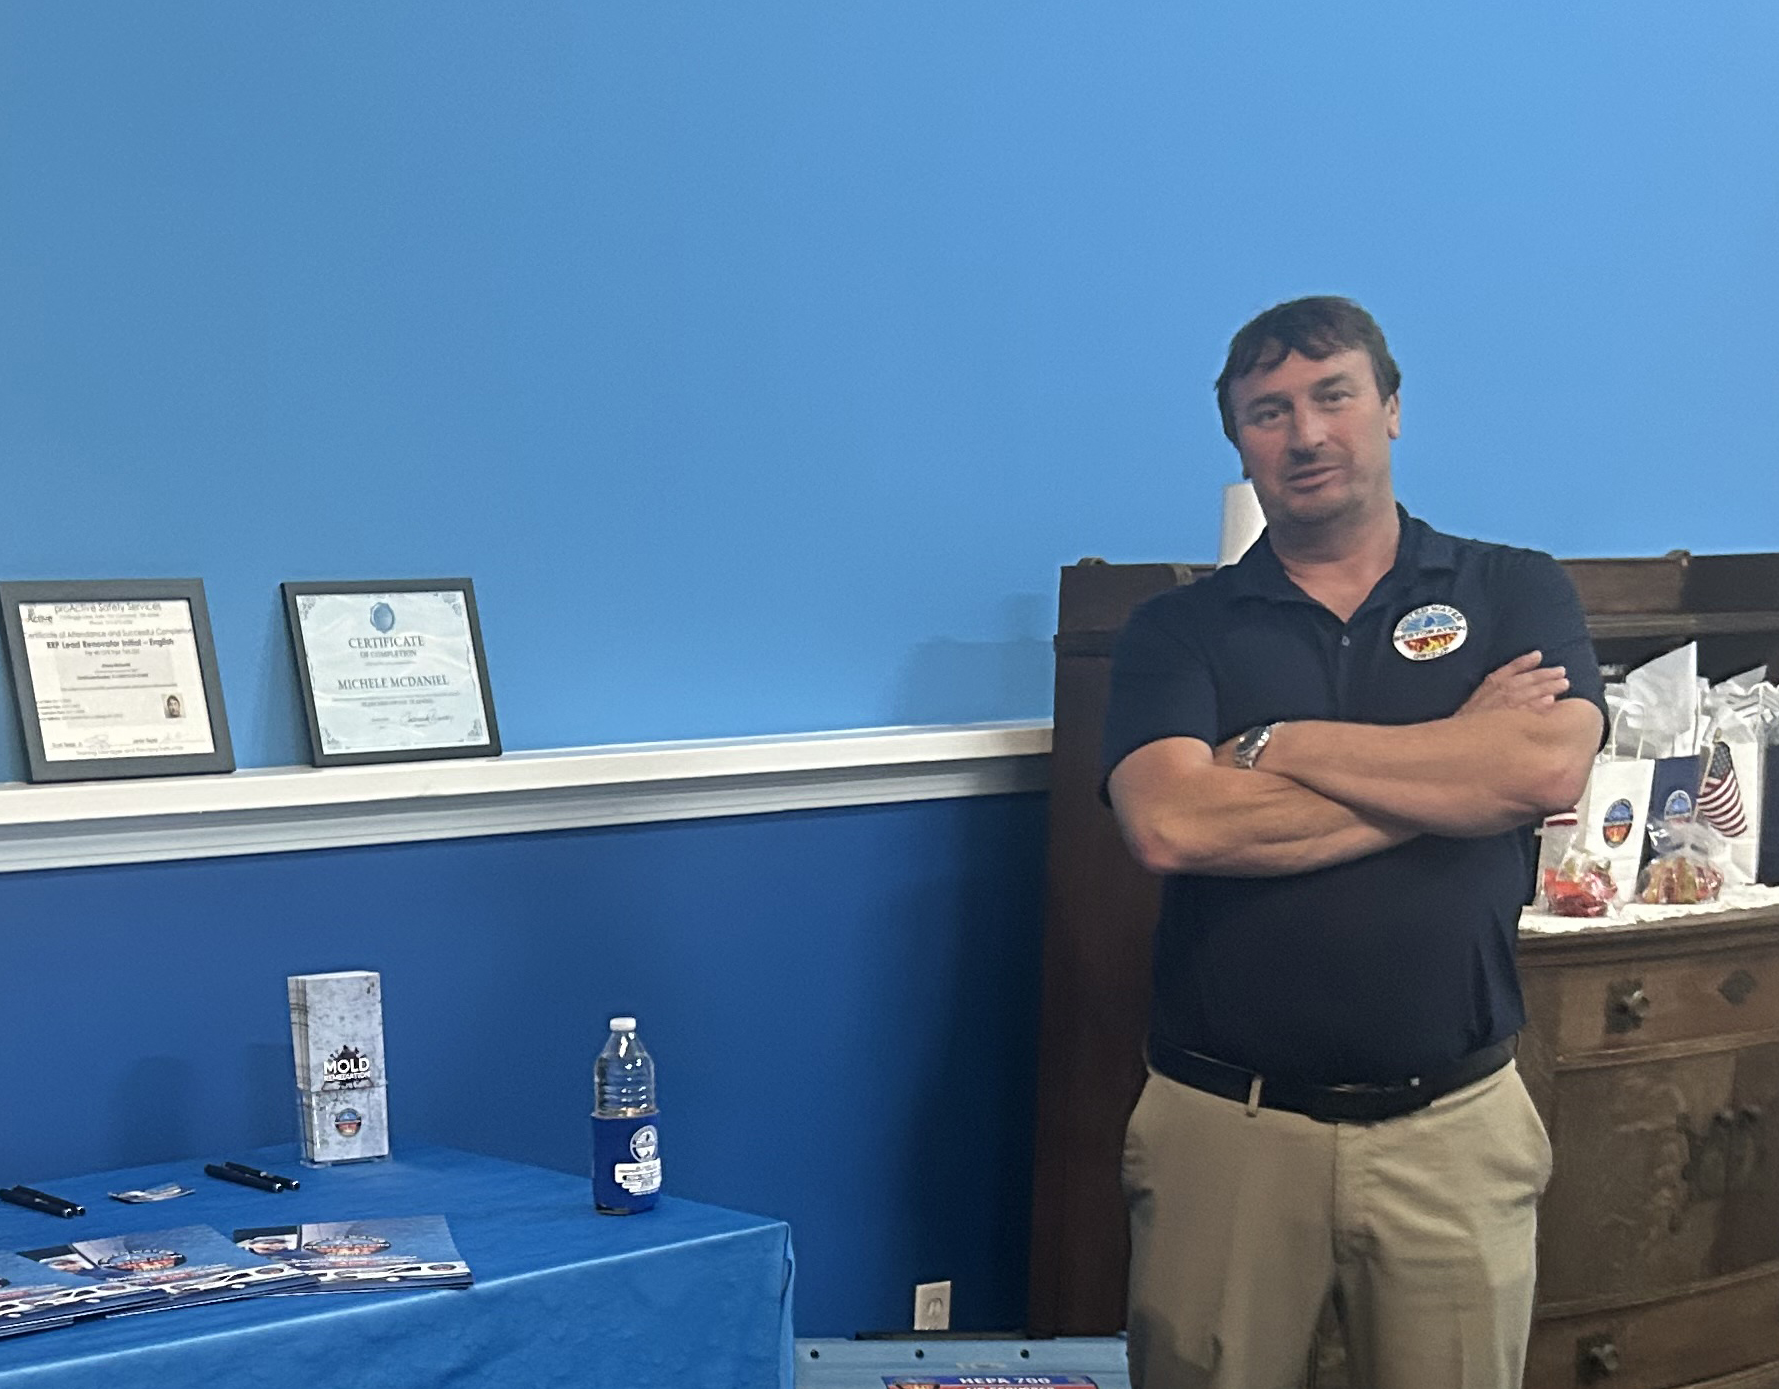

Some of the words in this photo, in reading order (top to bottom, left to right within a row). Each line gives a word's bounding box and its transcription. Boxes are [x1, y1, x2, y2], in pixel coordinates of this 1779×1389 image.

[348, 636, 425, 649] CERTIFICATE
[337, 677, 389, 690] MICHELE
[390, 674, 450, 688] MCDANIEL
[323, 1057, 370, 1075] MOLD
[958, 1376, 1010, 1385] HEPA
[1016, 1376, 1051, 1385] 700
